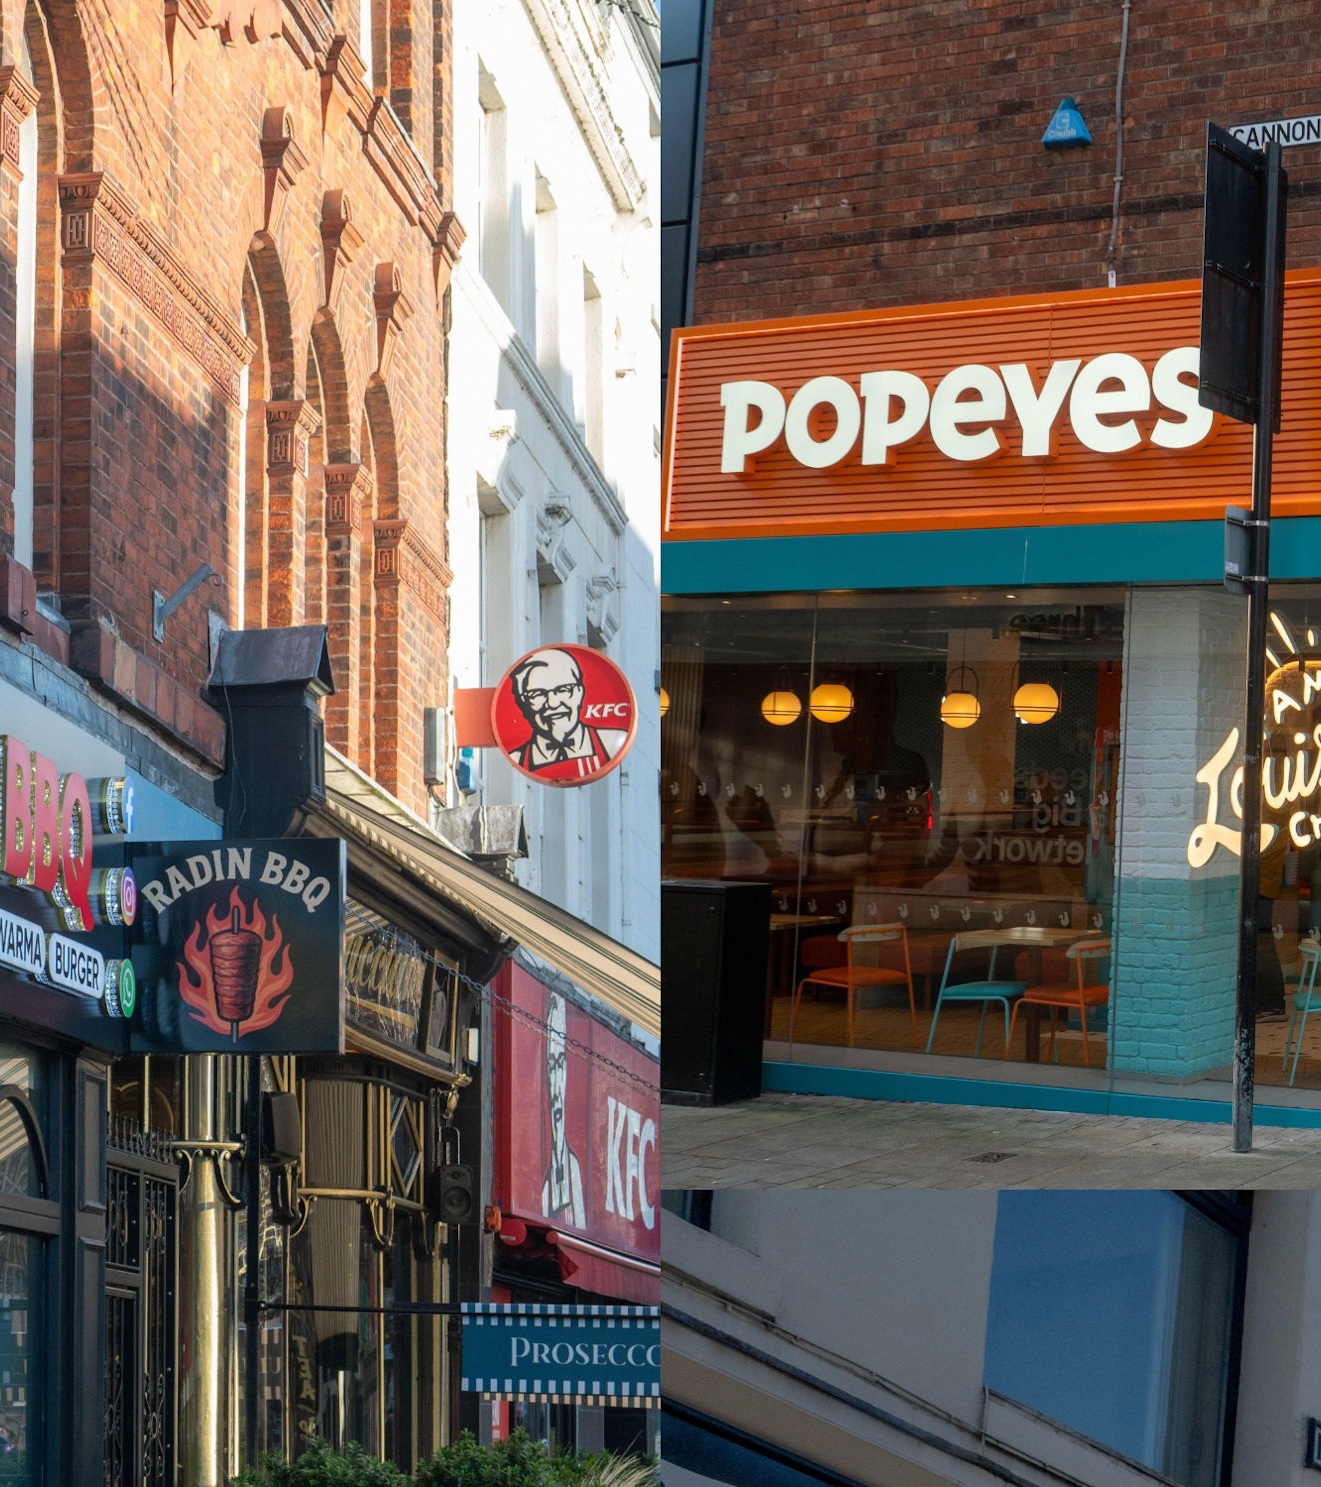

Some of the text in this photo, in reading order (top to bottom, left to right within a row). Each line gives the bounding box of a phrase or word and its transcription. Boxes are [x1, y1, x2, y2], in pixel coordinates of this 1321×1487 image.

[1233, 118, 1321, 148] CANNON
[584, 703, 629, 718] KFC
[4, 735, 93, 932] BBQ
[141, 847, 332, 915] RADIN BBQ
[55, 948, 100, 993] BURGER
[604, 1095, 657, 1232] KFC
